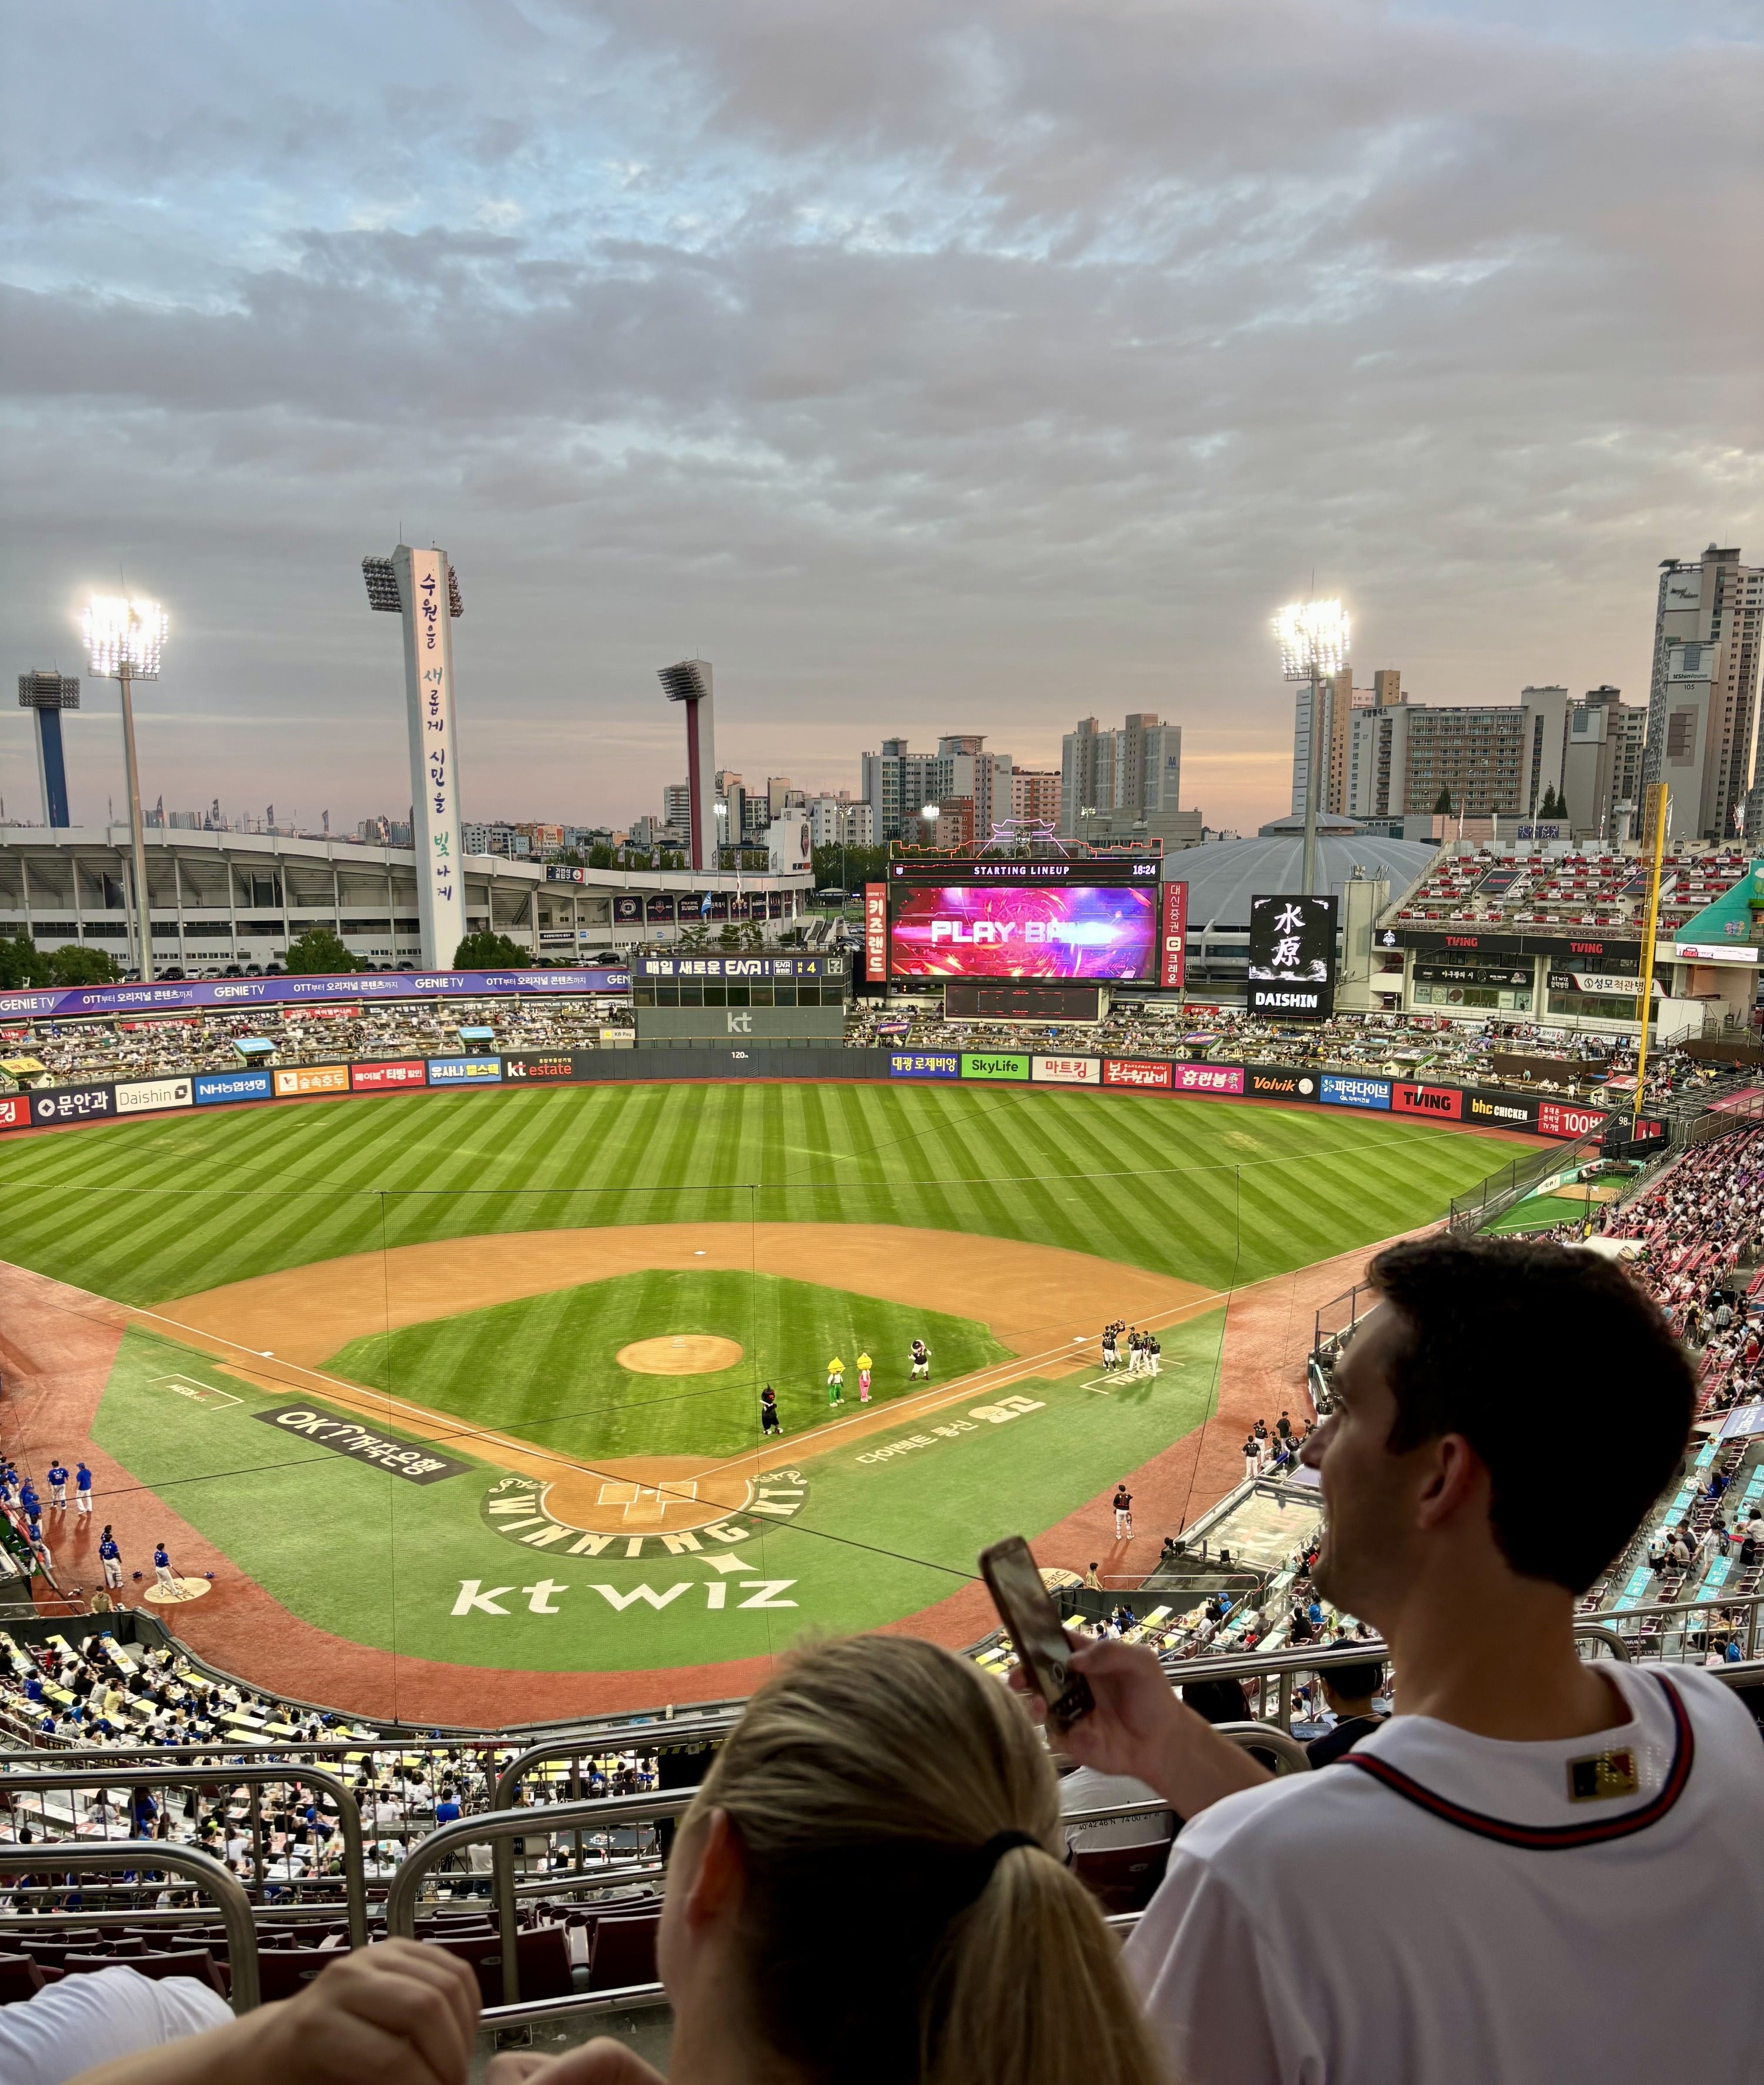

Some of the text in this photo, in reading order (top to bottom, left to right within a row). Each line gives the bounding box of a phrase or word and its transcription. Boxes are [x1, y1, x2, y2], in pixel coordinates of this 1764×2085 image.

[420, 573, 452, 901] 수원을 새롭게 시민을 빛나게
[974, 866, 1070, 875] STARTING LINEUP
[1133, 865, 1155, 875] 18:24
[1169, 885, 1180, 933] 대신증권
[868, 899, 884, 972] 키즈랜드
[931, 921, 1016, 943] PLAY
[1271, 903, 1306, 967] 水原
[1446, 937, 1478, 947] TVING
[1570, 943, 1603, 954] TVING
[646, 961, 673, 975] 매일
[679, 961, 721, 975] 새로운
[807, 961, 816, 974] 4
[1168, 954, 1178, 984] 크레온
[293, 980, 397, 992] OTT부터 오리지널 콘텐츠까지
[415, 978, 464, 988] GENIE TV
[486, 976, 586, 985] OTT부터 오리지널 콘텐츠까지
[83, 990, 192, 1004] OTT부터 오리지널 콘텐츠까지
[214, 984, 265, 997] GENIE TV
[0, 997, 55, 1011] GENIE TV
[1255, 992, 1317, 1008] DAISHIN
[727, 1012, 752, 1033] kt
[431, 1065, 464, 1078] 유사나
[507, 1061, 572, 1077] kt estate
[892, 1057, 957, 1072] 대광 로제비앙
[972, 1060, 1019, 1074] SkyLife
[1045, 1060, 1087, 1078] 마트킹
[386, 1068, 406, 1080] 티빙
[407, 1069, 423, 1079] 할인
[1108, 1062, 1167, 1084] 본수원갈비
[1182, 1070, 1227, 1088] 홈런볼
[200, 1080, 266, 1095] NH농협생명
[299, 1074, 344, 1090] 숲속호두
[1253, 1077, 1296, 1092] Volvik
[1334, 1080, 1389, 1098] 파라다이브
[57, 1091, 109, 1116] 문안과
[119, 1089, 172, 1105] Daishin
[1404, 1088, 1451, 1111] TVING
[1472, 1098, 1528, 1121] bhc CHICKEN
[1549, 1124, 1559, 1132] 가입
[855, 1434, 938, 1465] 다이렉트
[930, 1419, 979, 1438] 통신
[488, 1489, 804, 1558] WINNING KT
[450, 1565, 800, 1615] kt wiz
